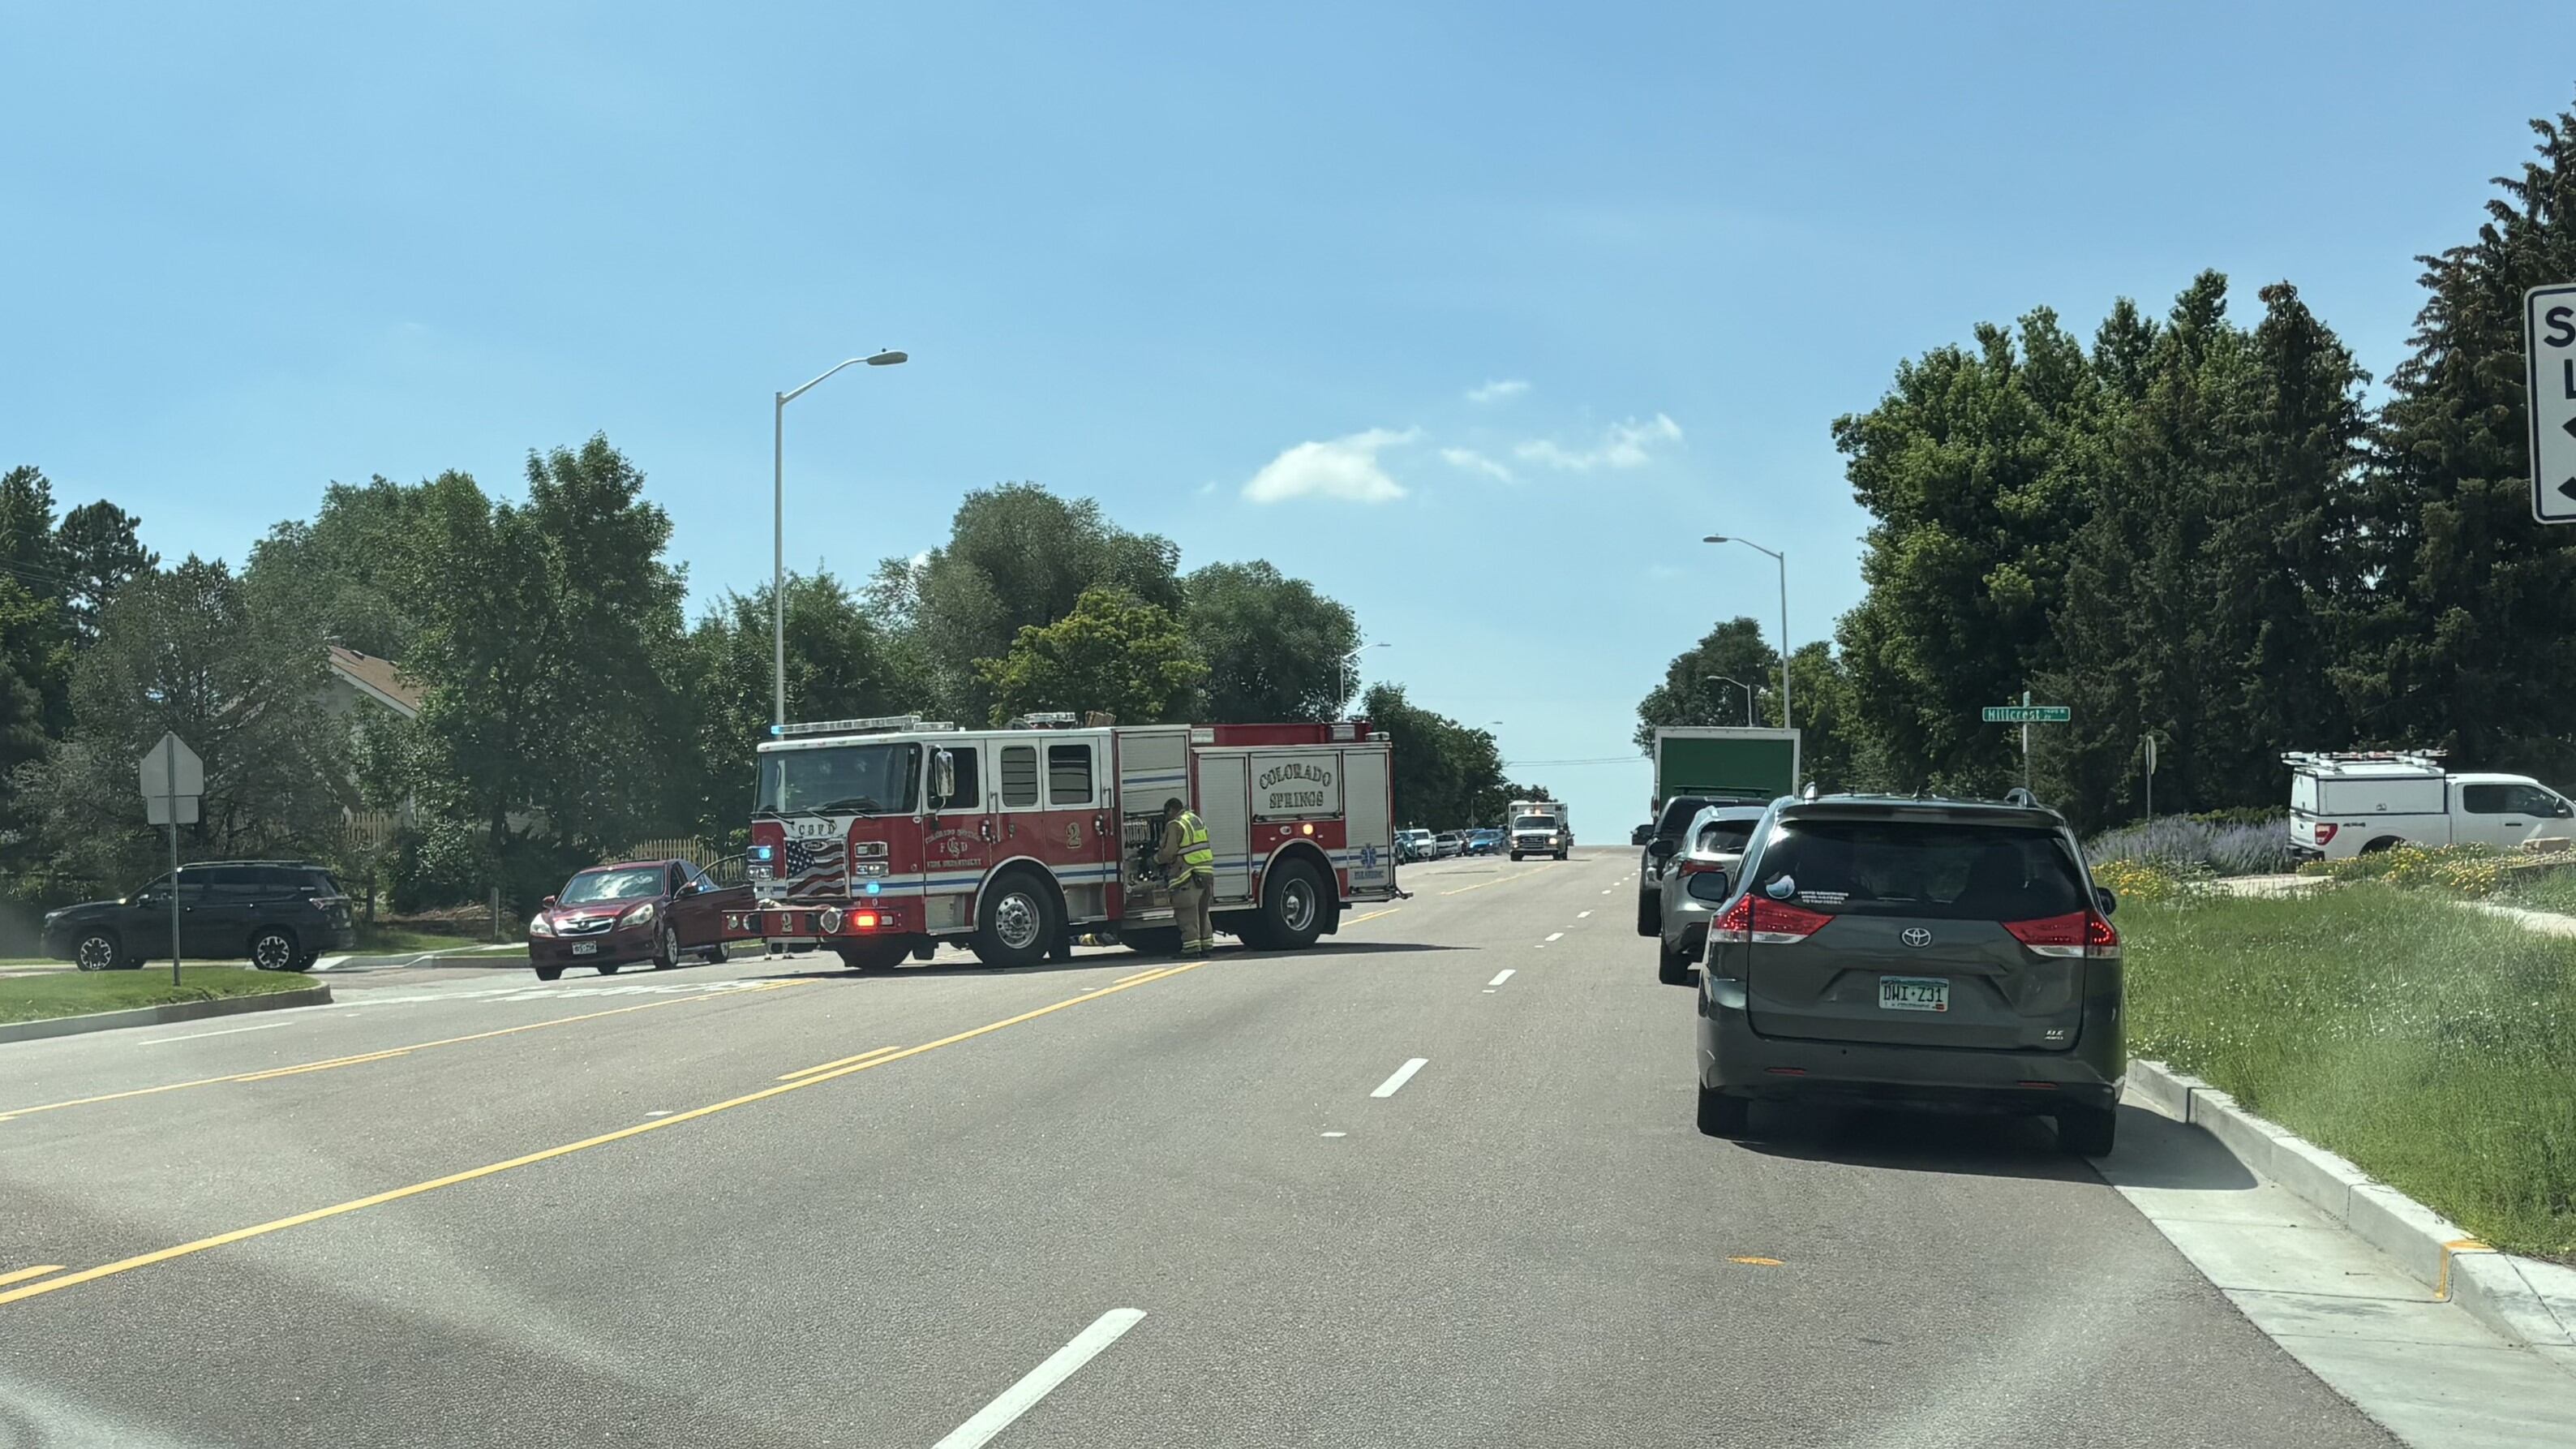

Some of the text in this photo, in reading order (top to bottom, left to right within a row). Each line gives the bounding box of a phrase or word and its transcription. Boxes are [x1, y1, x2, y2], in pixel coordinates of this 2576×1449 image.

[1987, 709, 2040, 721] Hillcrest
[1259, 763, 1332, 790] COLORADO
[1269, 791, 1324, 809] SPRINGS
[1065, 822, 1081, 849] 2
[780, 912, 792, 935] 2
